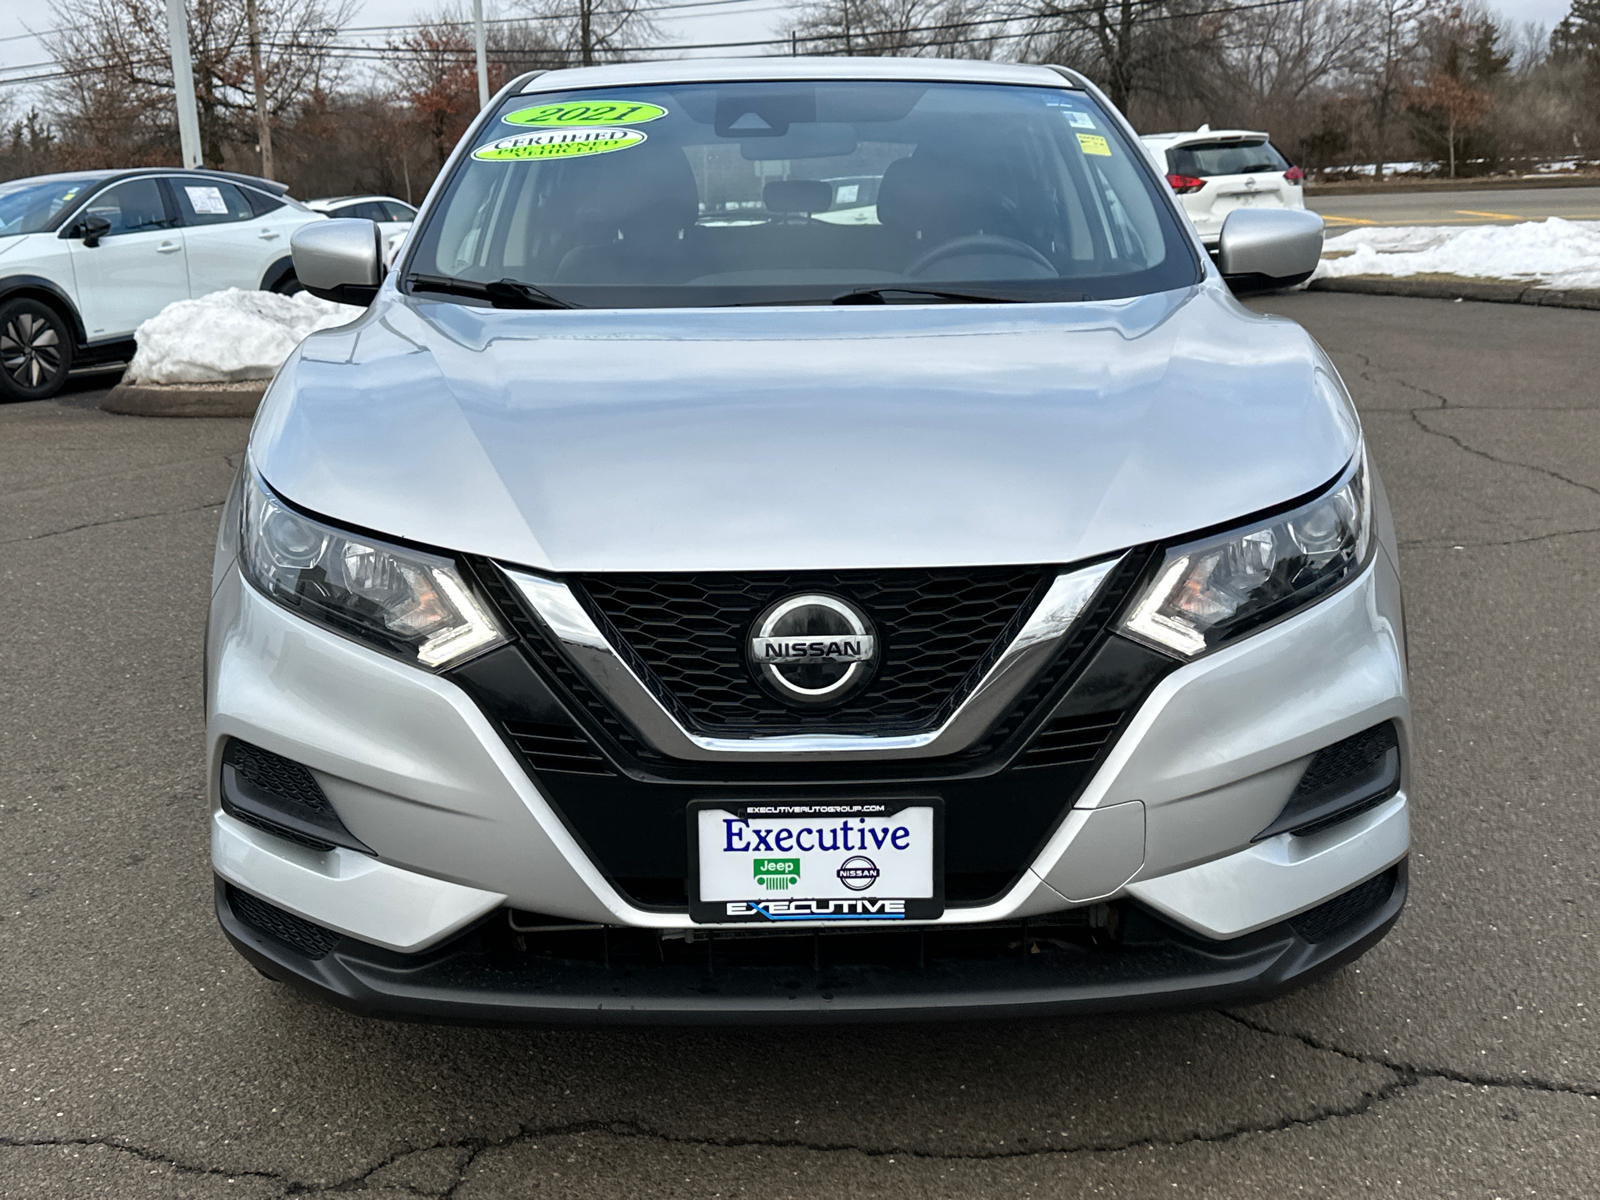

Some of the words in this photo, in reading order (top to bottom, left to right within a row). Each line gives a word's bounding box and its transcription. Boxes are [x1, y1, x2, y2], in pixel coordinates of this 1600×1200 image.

[524, 105, 644, 123] 2021
[494, 131, 628, 149] CERTIFIED
[765, 641, 861, 658] NISSAN
[746, 805, 885, 813] EXECUTIVEAUTOGROUP.COM
[722, 817, 910, 852] Executive
[760, 860, 794, 873] Jeep
[839, 869, 878, 877] NISSAN
[726, 900, 906, 918] EXECUTIVE
